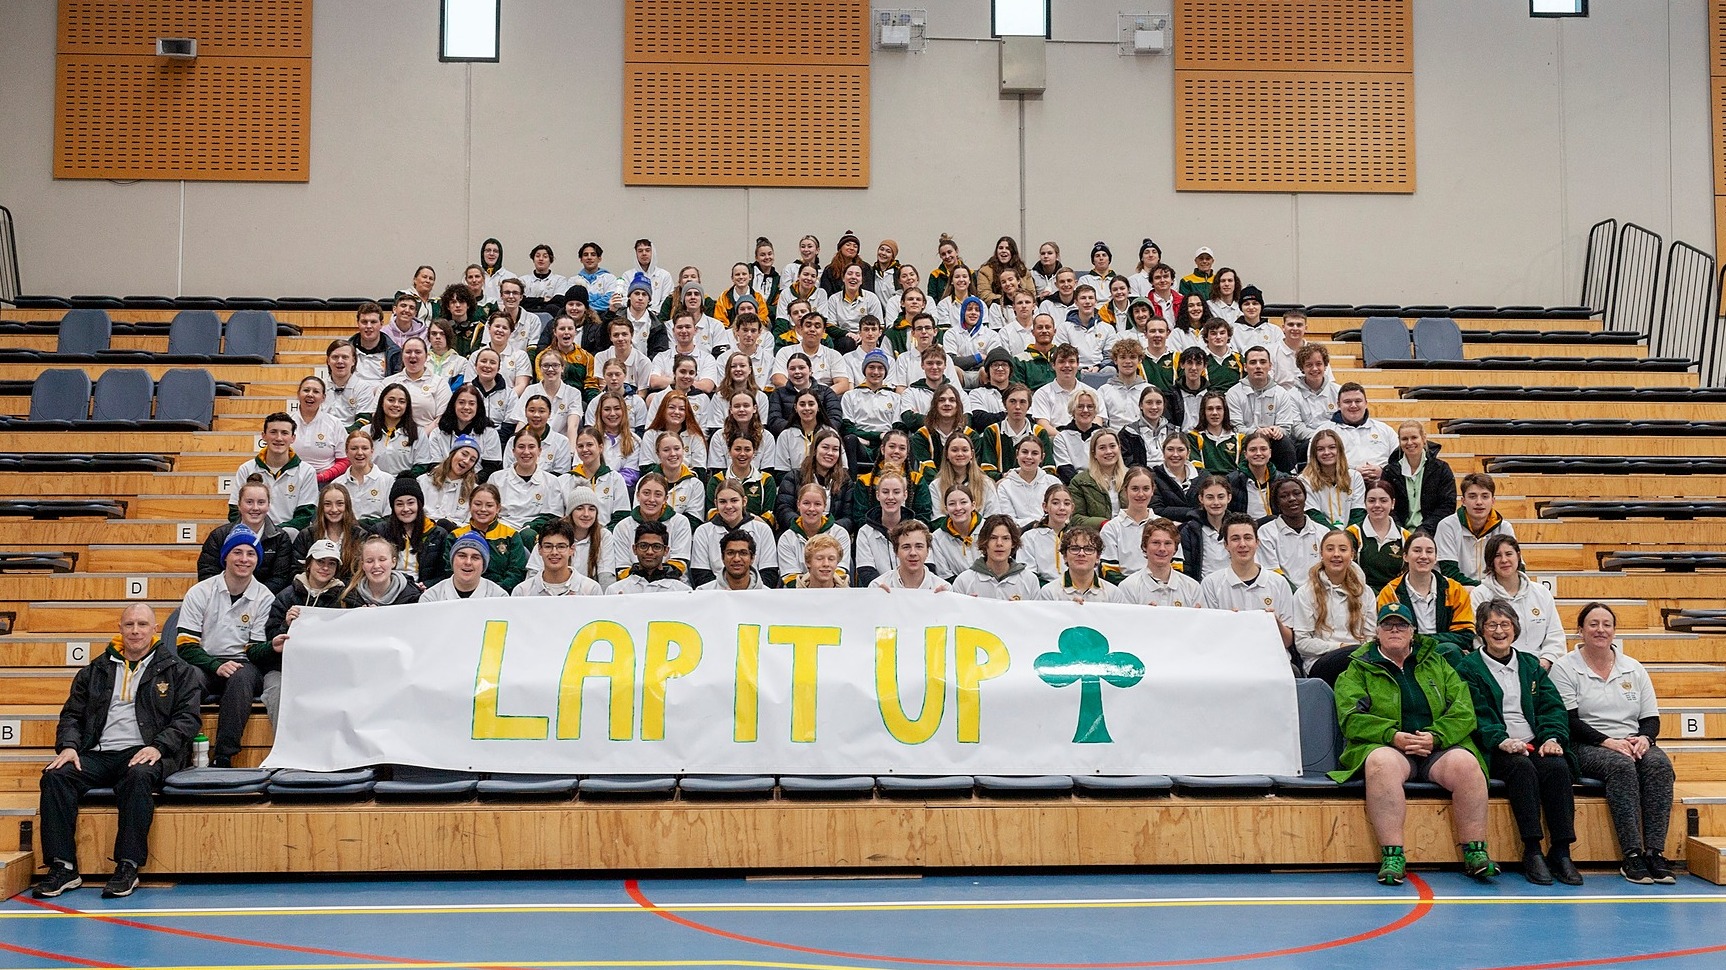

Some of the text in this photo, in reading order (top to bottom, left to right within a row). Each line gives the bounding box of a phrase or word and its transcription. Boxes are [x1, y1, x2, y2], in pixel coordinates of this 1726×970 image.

[290, 403, 299, 412] H
[258, 438, 268, 448] G
[223, 479, 232, 490] F
[182, 527, 191, 539] E
[131, 582, 142, 595] D
[72, 647, 84, 661] C
[471, 620, 1011, 745] LAP IT UP
[1687, 718, 1698, 733] B
[2, 725, 14, 740] B
